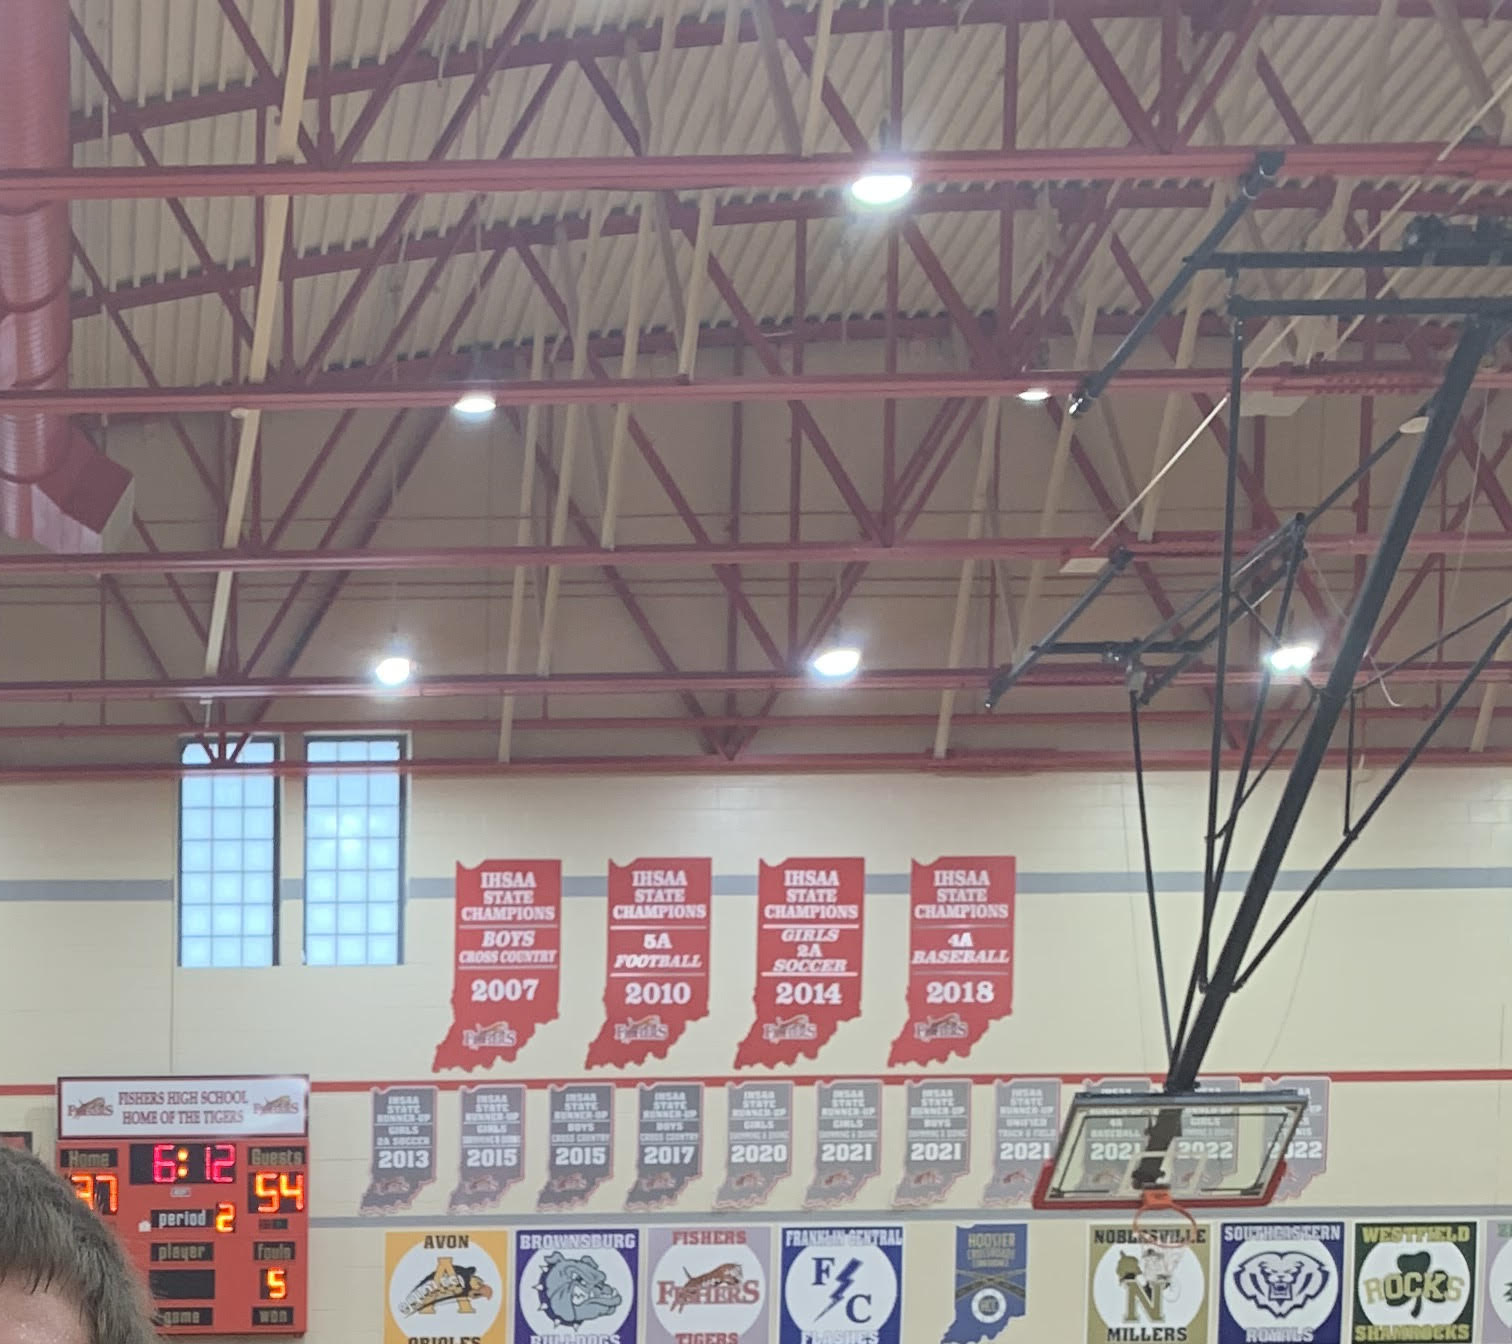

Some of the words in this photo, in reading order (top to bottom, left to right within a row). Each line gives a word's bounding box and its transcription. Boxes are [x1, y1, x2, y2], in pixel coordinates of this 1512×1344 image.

[480, 872, 536, 888] IHSAA
[632, 870, 687, 887] IHSAA
[784, 870, 839, 886] IHSAA
[933, 870, 990, 886] IHSAA
[483, 890, 534, 905] STATE
[634, 888, 685, 902] STATE
[786, 888, 837, 902] STATE
[936, 888, 987, 902] STATE
[461, 906, 555, 921] CHAMPIONS
[612, 905, 706, 919] CHAMPIONS
[764, 905, 858, 919] CHAMPIONS
[914, 905, 1008, 919] CHAMPIONS
[482, 931, 535, 947] BOYS
[643, 933, 672, 949] 5A
[781, 928, 839, 942] GIRLS
[947, 932, 973, 947] 4A
[458, 951, 498, 963] CROSS
[499, 950, 556, 963] COUNTRY
[797, 943, 822, 958] 2A
[912, 951, 1009, 964] BASEBALL
[614, 954, 702, 968] FOOTBALL
[772, 959, 847, 972] SOCCER
[471, 979, 539, 1001] 2007
[625, 983, 691, 1004] 2010
[776, 983, 842, 1004] 2014
[926, 981, 994, 1004] 2018
[118, 1092, 164, 1105] FISHERS
[167, 1091, 198, 1105] HIGH
[200, 1091, 248, 1105] SCHOOL
[122, 1111, 158, 1125] HOME
[160, 1111, 175, 1124] OF
[178, 1111, 200, 1124] THE
[202, 1110, 243, 1124] TIGERS
[388, 1126, 419, 1135] GIRLS
[476, 1125, 507, 1133] GIRLS
[68, 1150, 109, 1167] Home
[251, 1147, 303, 1165] Guests
[466, 1149, 518, 1167] 2015
[555, 1147, 606, 1165] 2015
[644, 1146, 695, 1164] 2017
[731, 1144, 787, 1163] 2020
[821, 1143, 872, 1162] 2021
[910, 1142, 962, 1161] 2021
[1000, 1142, 1050, 1160] 2021
[152, 1144, 236, 1184] 6:12
[378, 1150, 429, 1169] 2013
[254, 1171, 304, 1213] 54
[158, 1210, 207, 1229] period
[215, 1201, 236, 1233] 2
[672, 1230, 747, 1246] FISHERS
[1224, 1225, 1341, 1241] SOUTHEASTERN
[1362, 1226, 1471, 1244] WESTFIELD
[424, 1235, 469, 1249] AVON
[519, 1234, 636, 1250] BROWNSBURG
[158, 1243, 205, 1260] player
[811, 1257, 835, 1286] F
[266, 1267, 286, 1299] 5
[1363, 1271, 1465, 1304] ROCKS
[846, 1294, 872, 1324] C
[1123, 1280, 1166, 1323] N
[259, 1310, 287, 1322] won
[1107, 1327, 1188, 1342] MILLERS
[1246, 1327, 1314, 1343] ROYALS
[1354, 1324, 1469, 1342] SHAMROCKS
